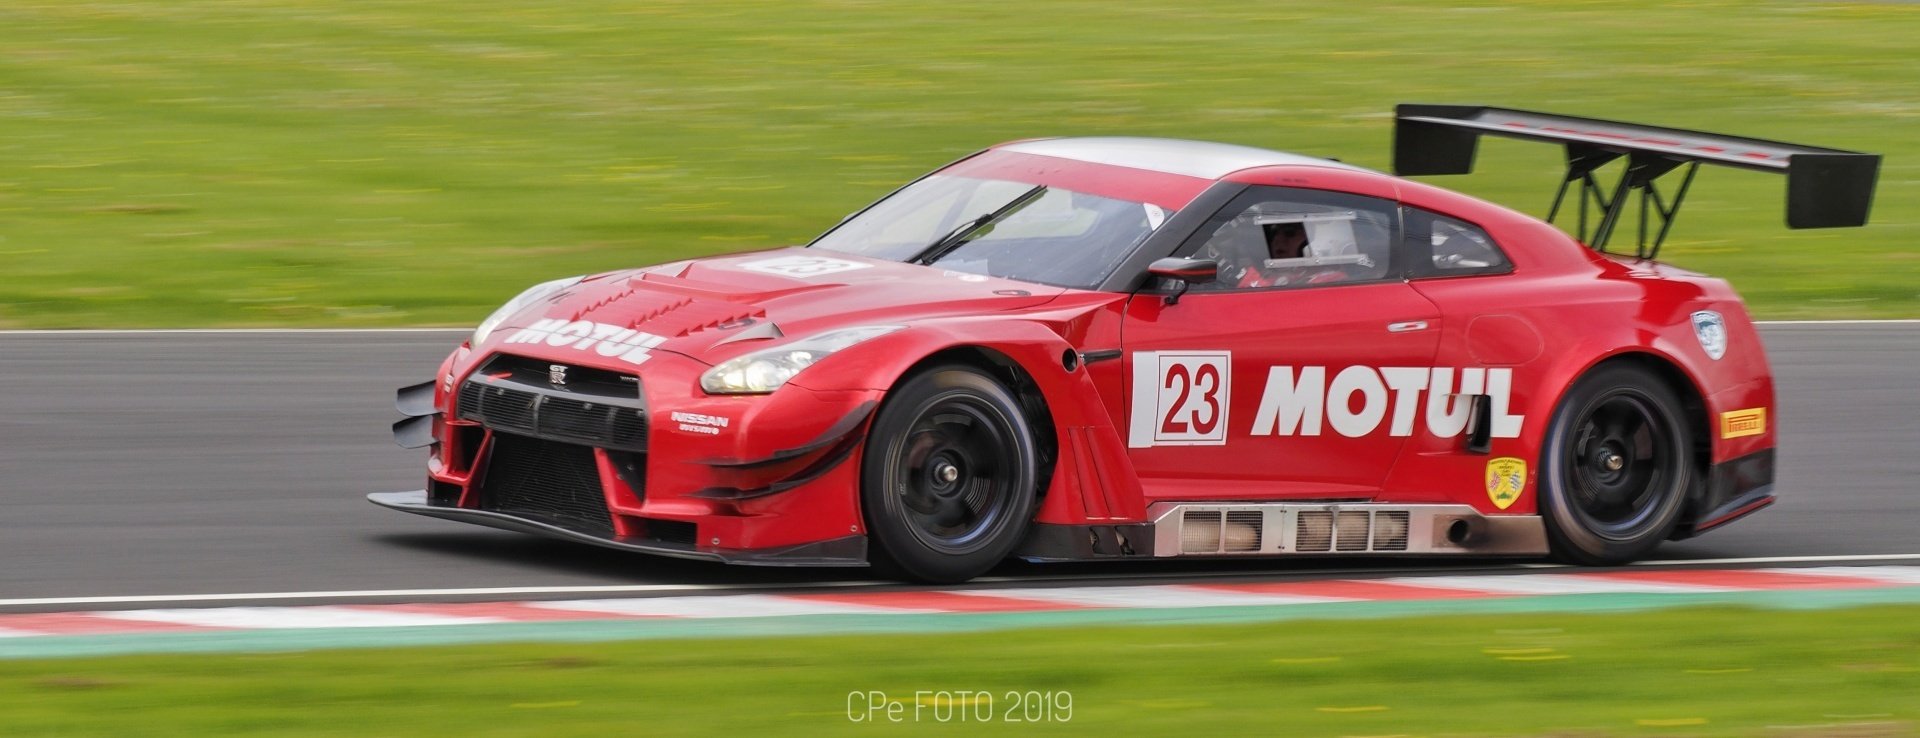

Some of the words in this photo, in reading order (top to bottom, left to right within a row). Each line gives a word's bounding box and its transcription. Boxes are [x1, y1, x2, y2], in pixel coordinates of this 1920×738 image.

[503, 318, 669, 365] MOTUL
[671, 411, 729, 428] NISSAN
[1161, 363, 1220, 434] 23
[1250, 365, 1525, 438] MOTUL
